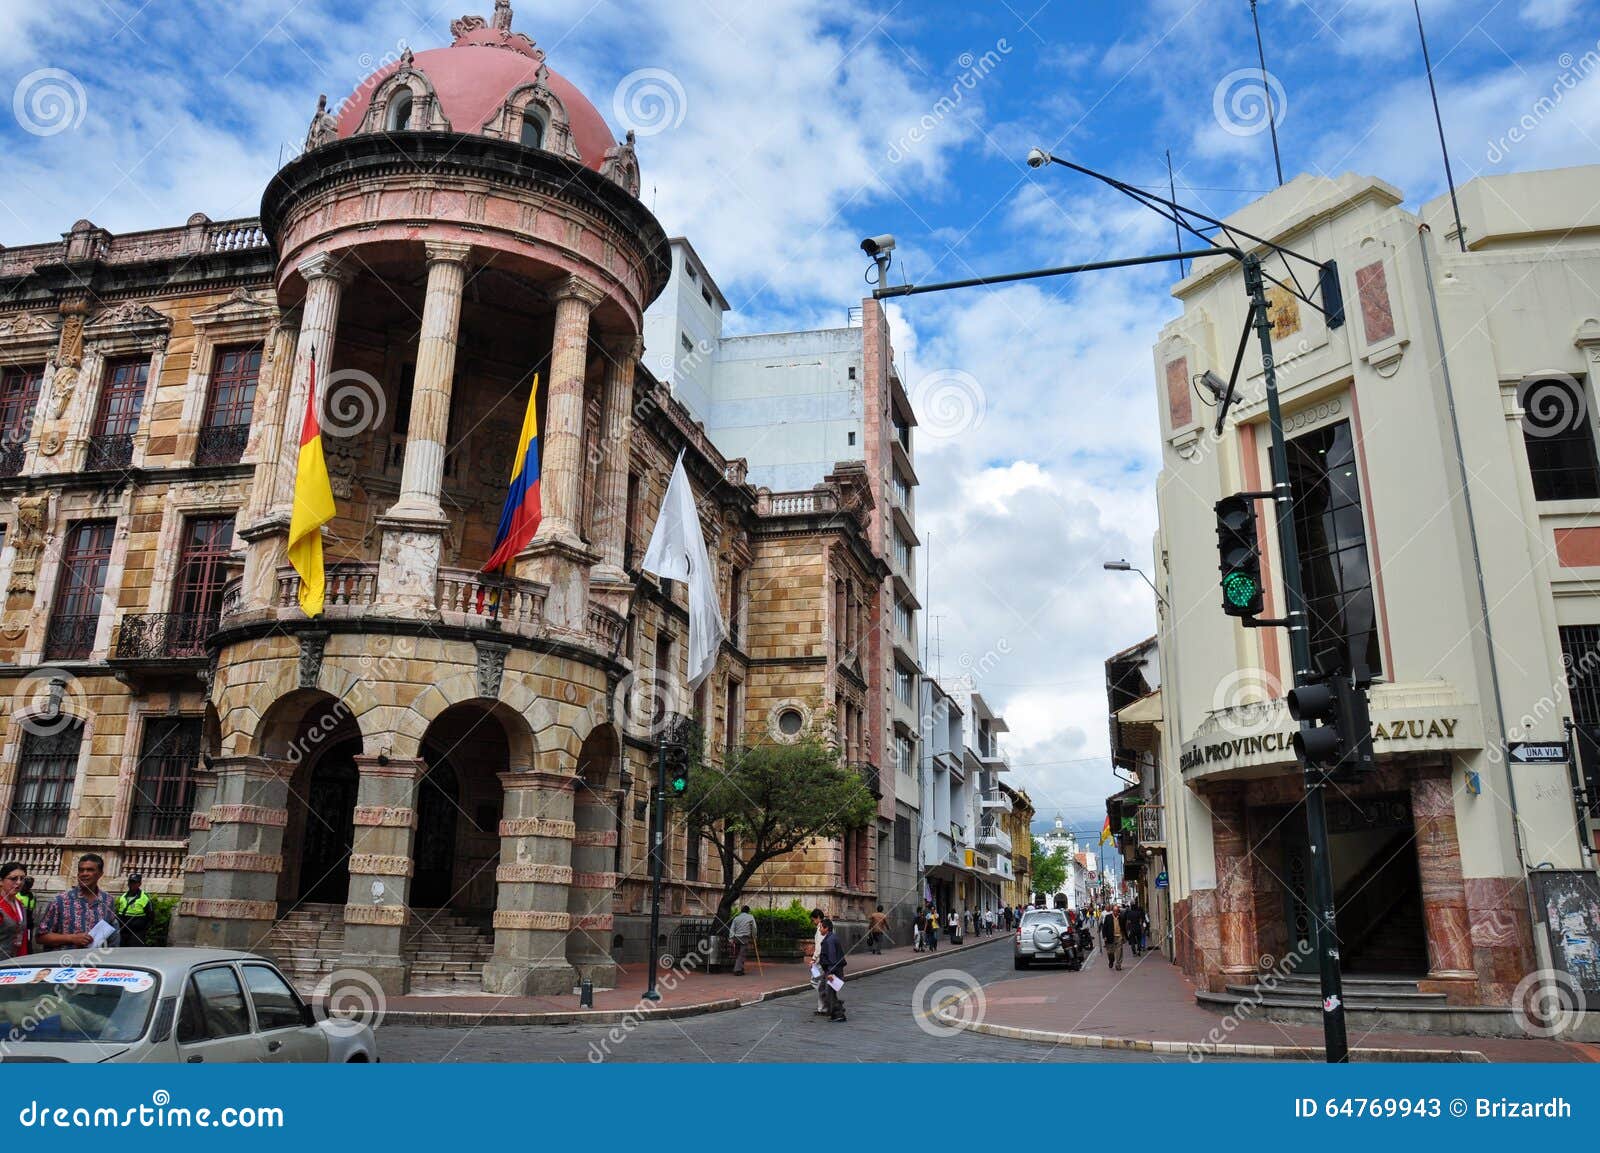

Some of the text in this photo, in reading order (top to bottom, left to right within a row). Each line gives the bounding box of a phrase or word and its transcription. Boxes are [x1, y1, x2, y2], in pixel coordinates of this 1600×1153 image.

[1205, 731, 1296, 763] PROVINCIA
[1373, 718, 1458, 741] AZUAY
[1526, 748, 1559, 757] UNA VIA
